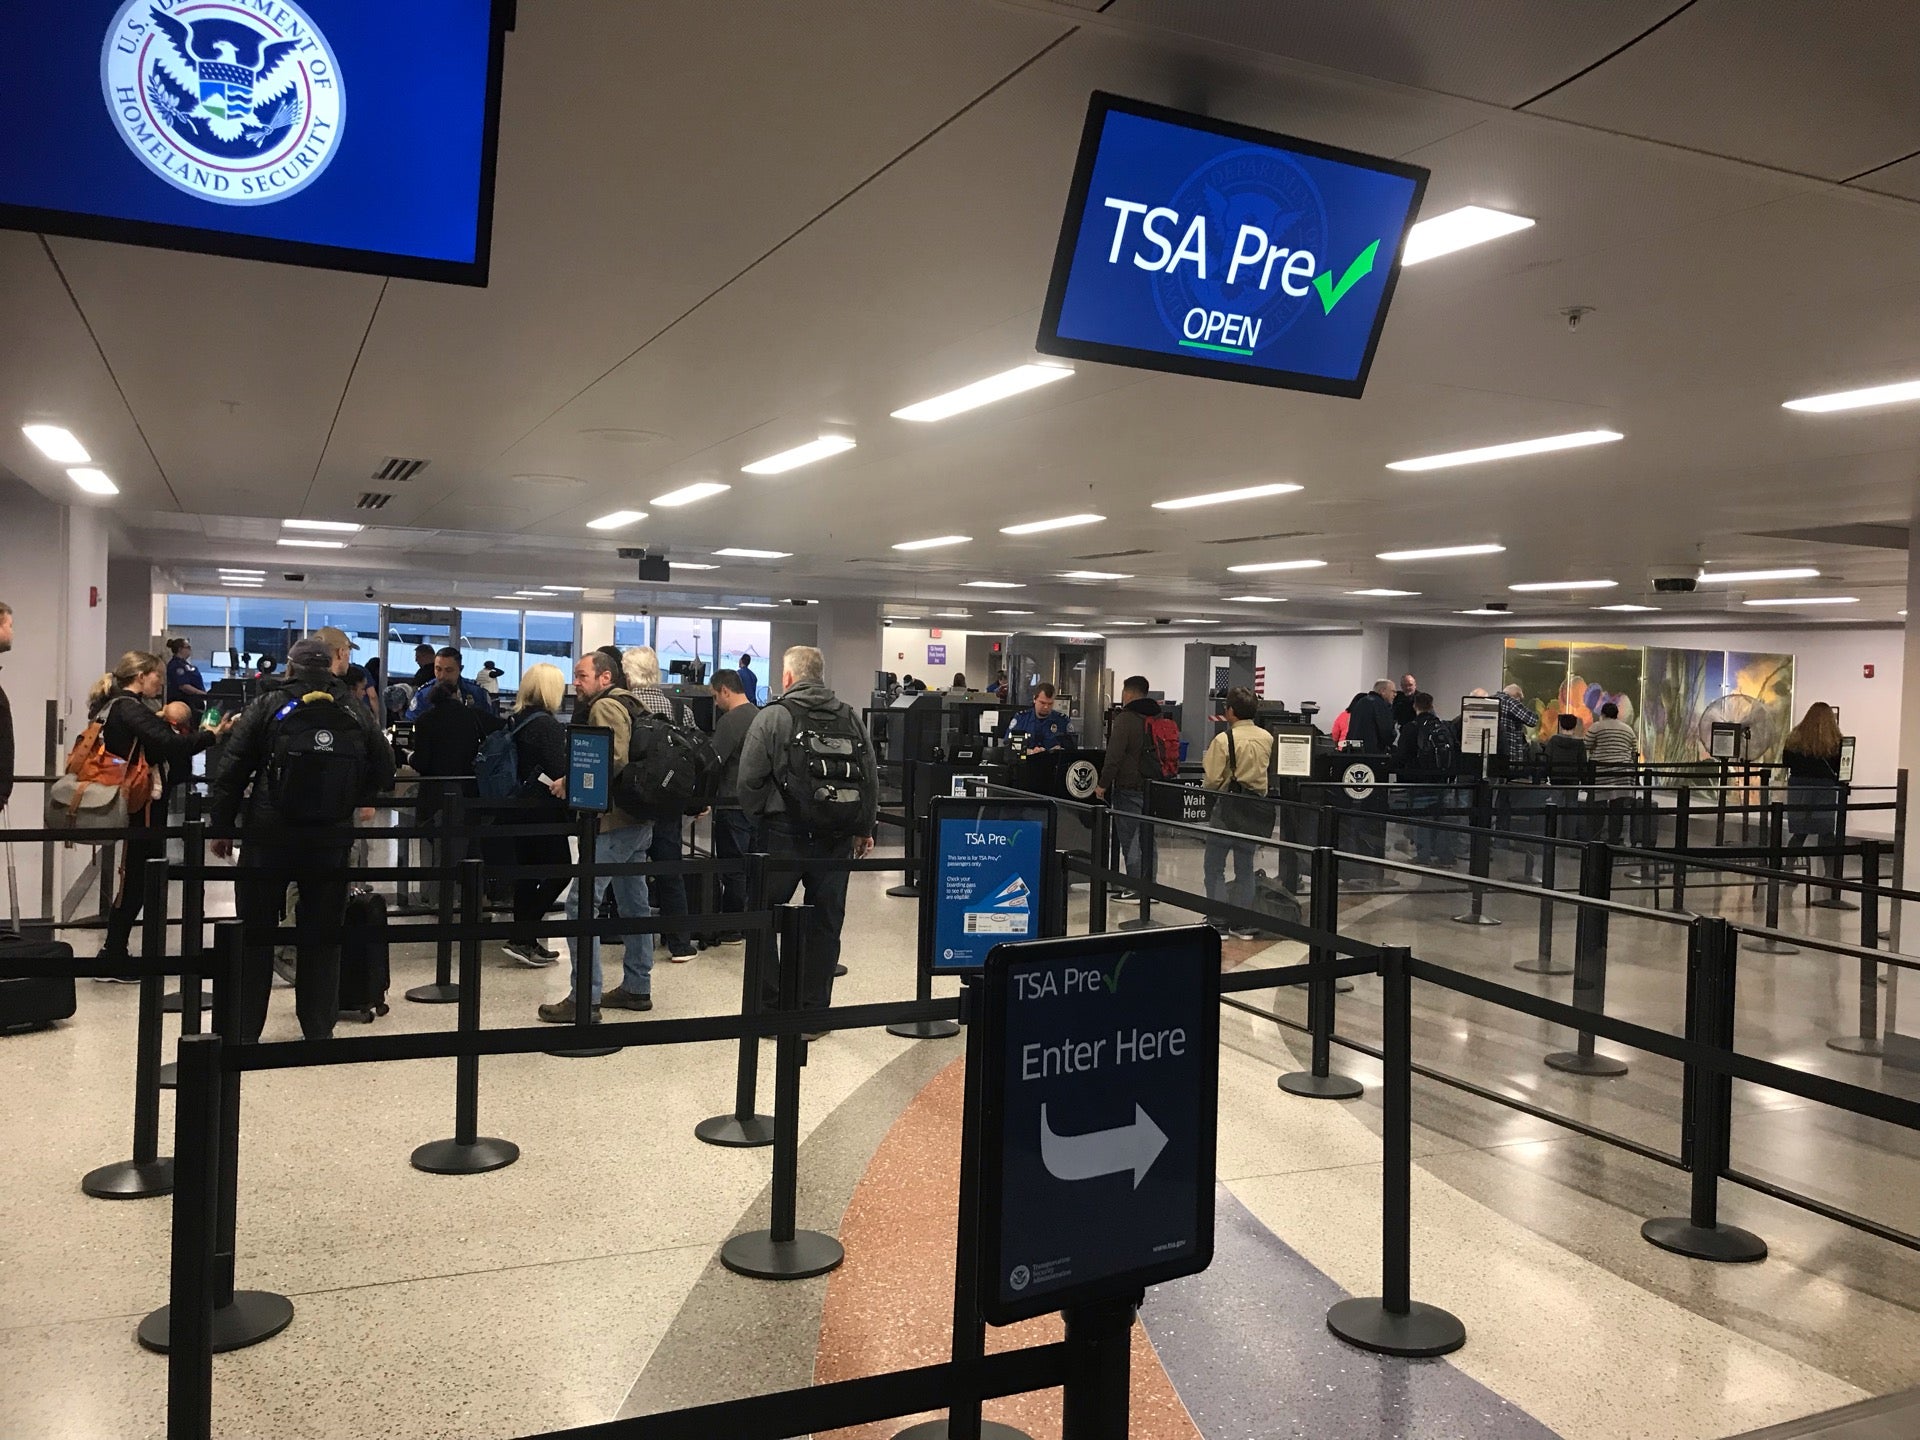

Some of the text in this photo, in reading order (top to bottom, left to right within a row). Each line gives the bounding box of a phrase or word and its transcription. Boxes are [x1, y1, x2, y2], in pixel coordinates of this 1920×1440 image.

[117, 18, 149, 55] U.S.
[309, 58, 332, 90] OF
[116, 85, 331, 194] HOMELAND SECURITY
[1104, 197, 1207, 279] TSA
[1226, 224, 1316, 297] Pre
[1183, 307, 1262, 348] OPEN
[1184, 795, 1205, 806] Wait
[1184, 808, 1206, 819] Here
[965, 833, 1006, 845] TSA Pre
[1014, 966, 1100, 1000] TSA Pre
[1021, 1027, 1186, 1081] Enter Here
